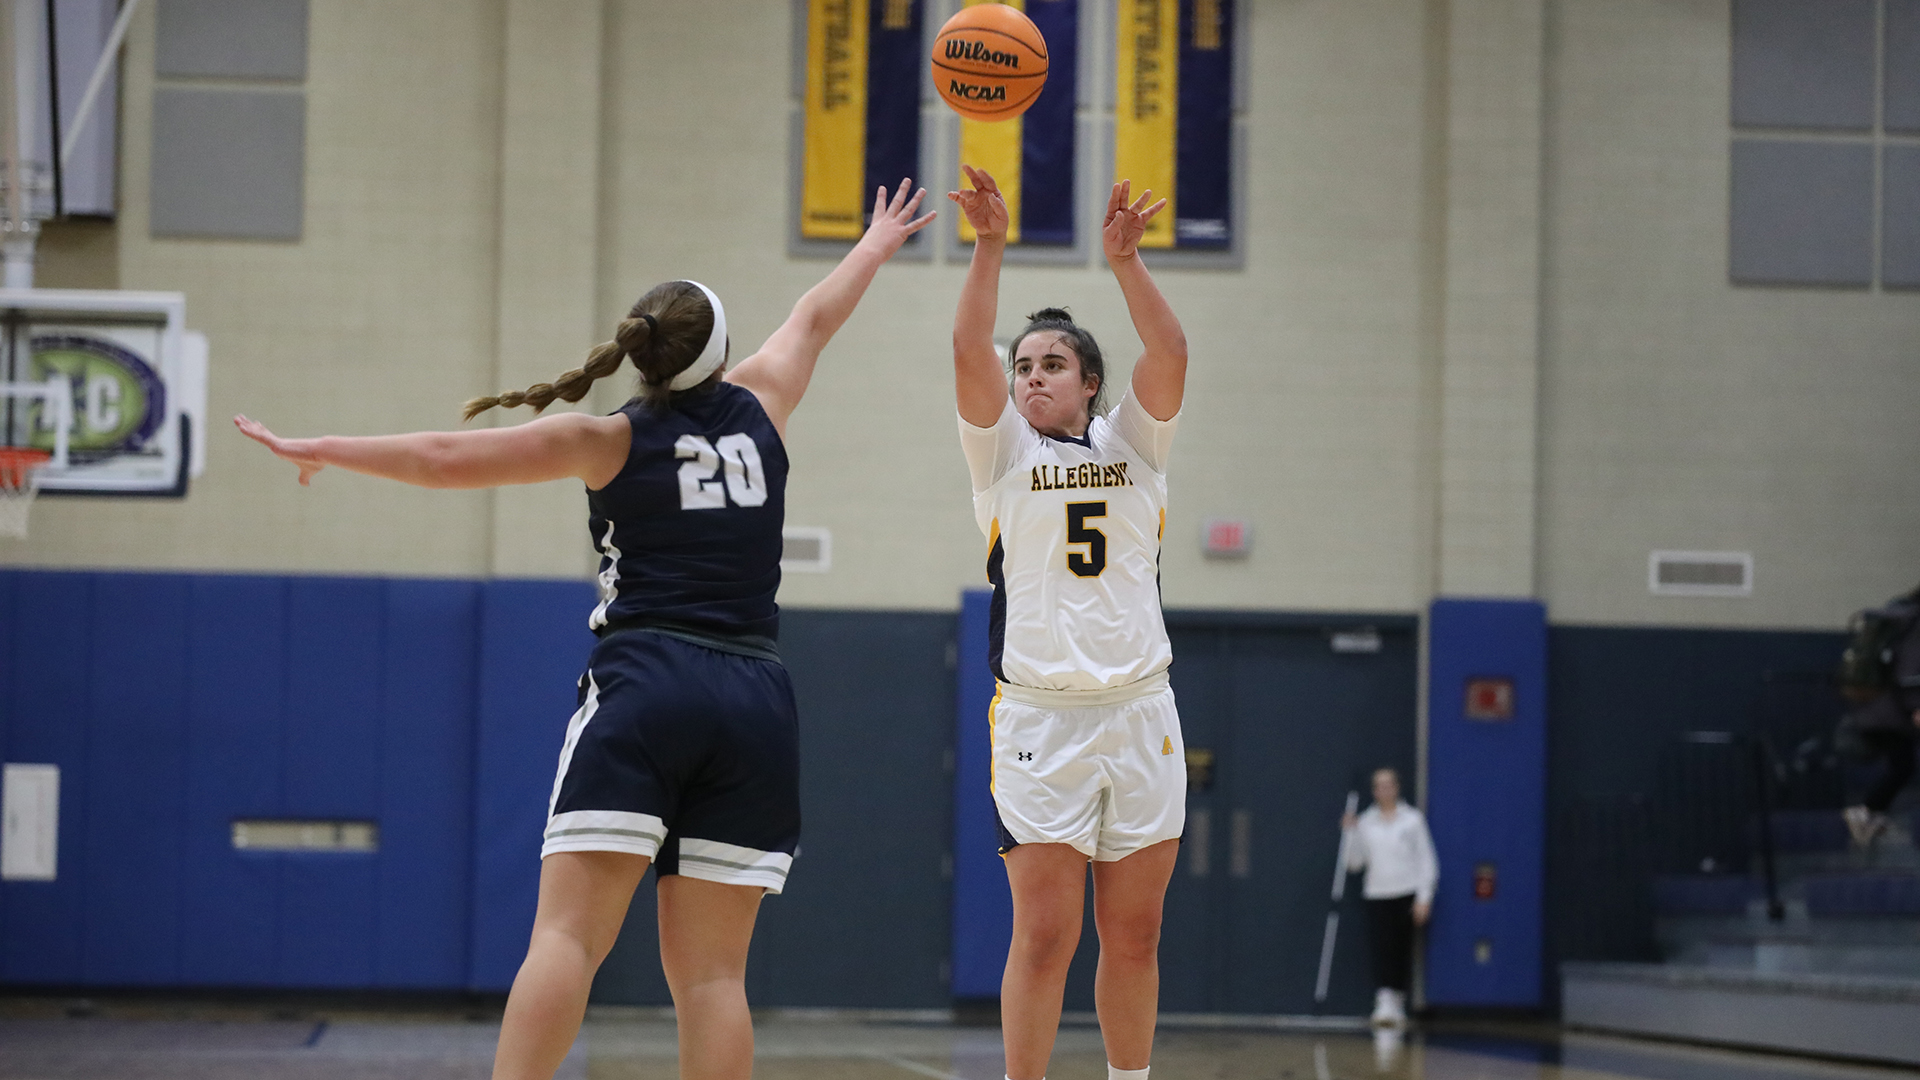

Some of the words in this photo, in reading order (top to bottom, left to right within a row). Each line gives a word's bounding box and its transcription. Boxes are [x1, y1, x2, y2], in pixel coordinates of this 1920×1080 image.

[945, 39, 1019, 69] Wilson
[949, 79, 1006, 101] NCAA
[674, 432, 768, 510] 20
[1064, 499, 1108, 579] 5
